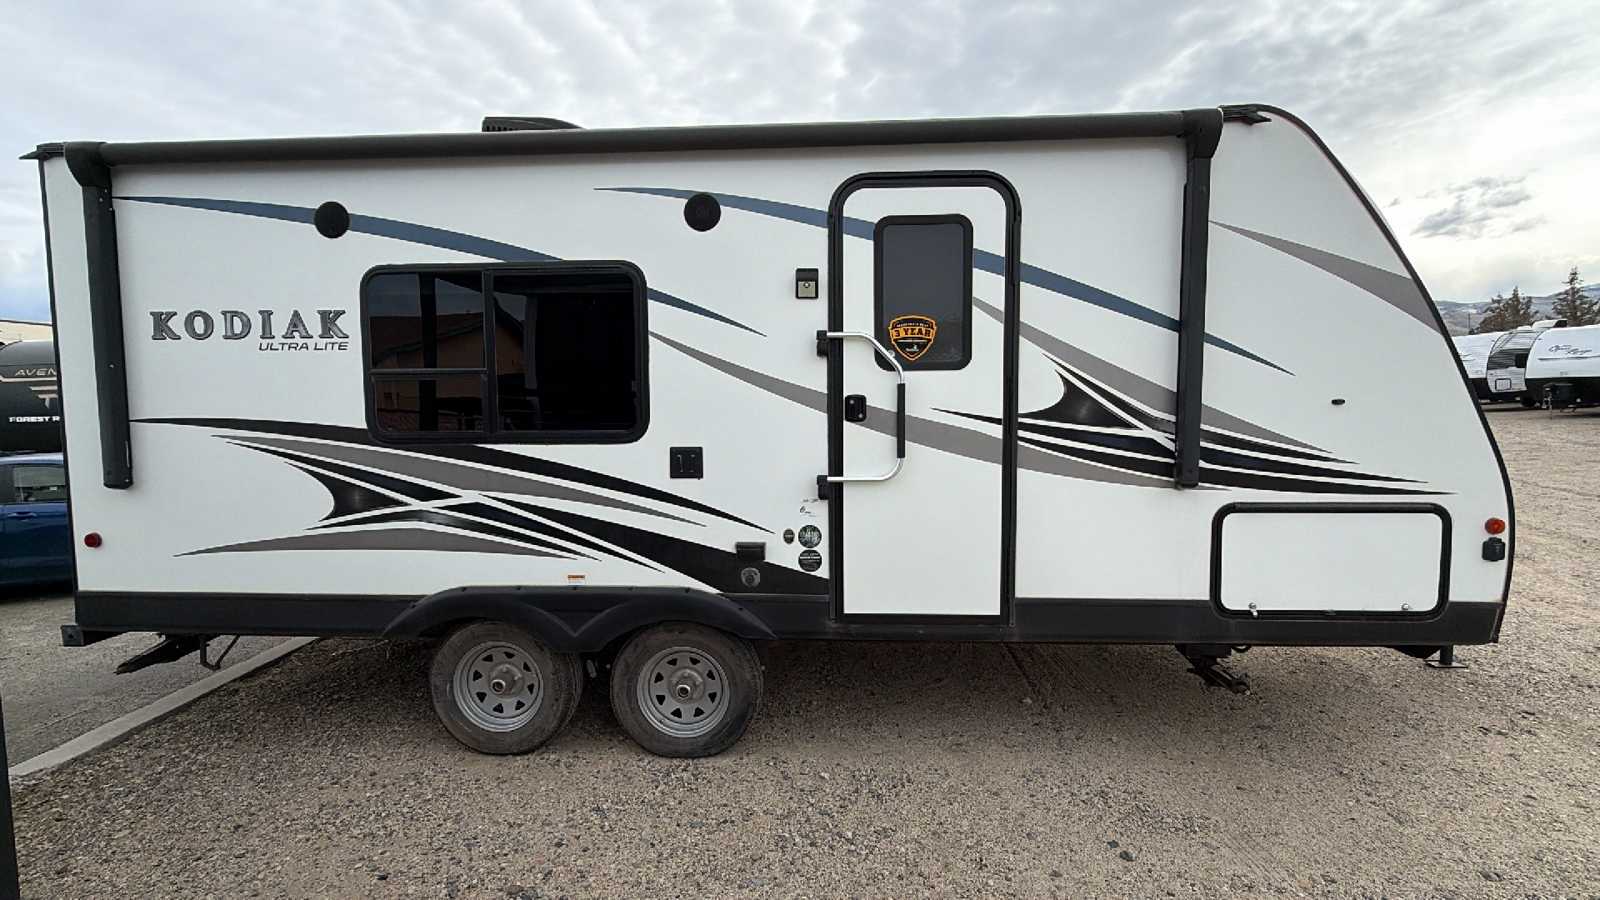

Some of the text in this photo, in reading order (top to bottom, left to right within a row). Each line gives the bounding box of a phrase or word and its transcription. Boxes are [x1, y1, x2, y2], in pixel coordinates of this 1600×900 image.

[150, 309, 349, 341] KODIAK
[902, 327, 931, 337] YEAR
[258, 342, 349, 351] ULTRA LITE
